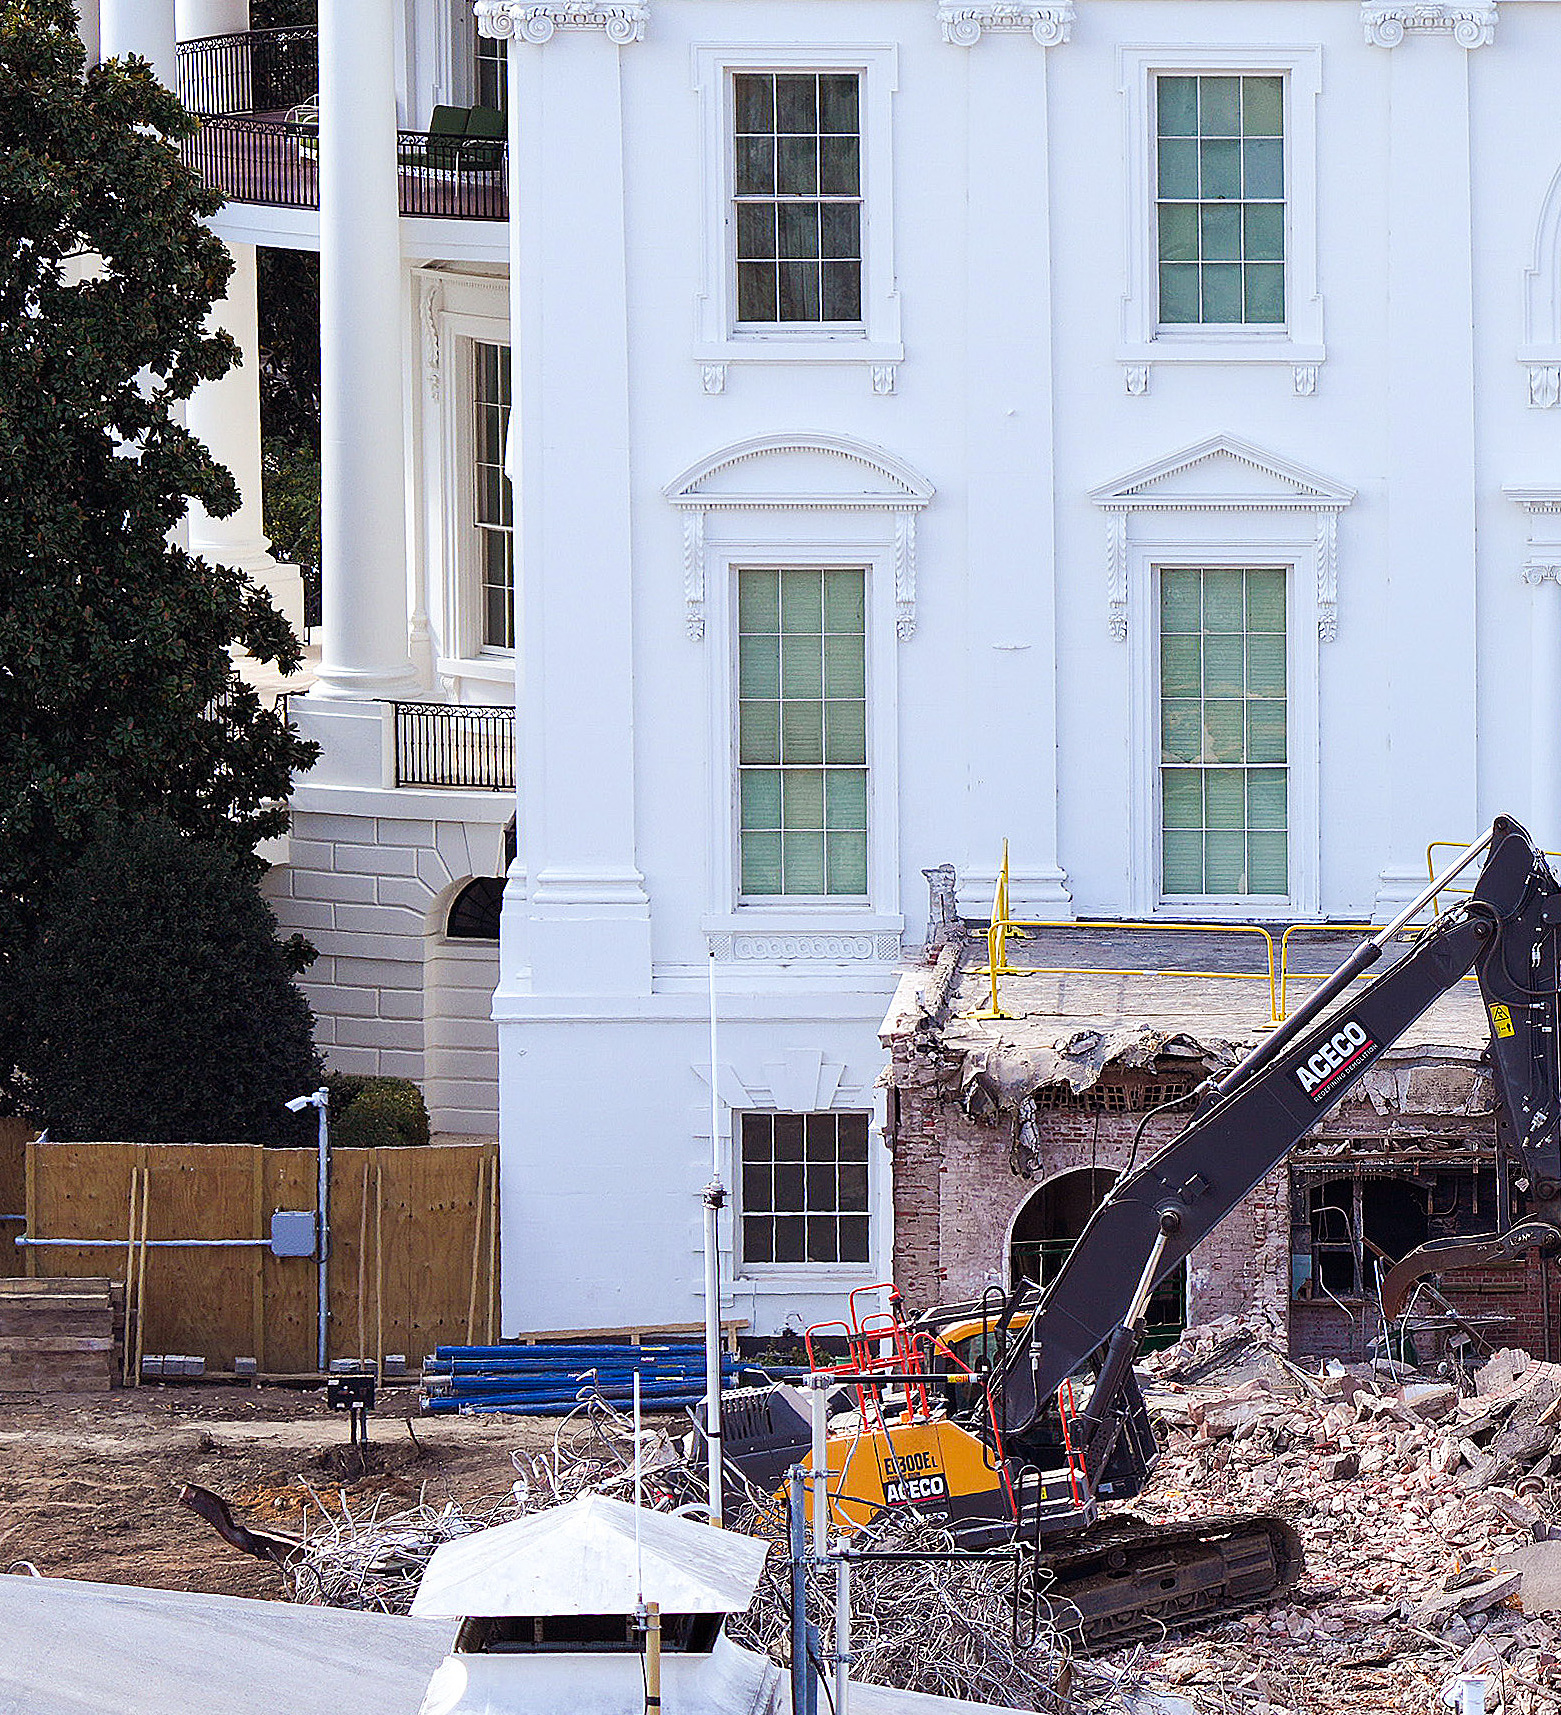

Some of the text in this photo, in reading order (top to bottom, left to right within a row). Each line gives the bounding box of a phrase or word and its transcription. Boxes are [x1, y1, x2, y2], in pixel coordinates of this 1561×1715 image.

[1295, 1021, 1367, 1093] ACECO
[1313, 1043, 1379, 1103] REDEFINING DEMOLITION
[887, 1476, 944, 1503] ACECO
